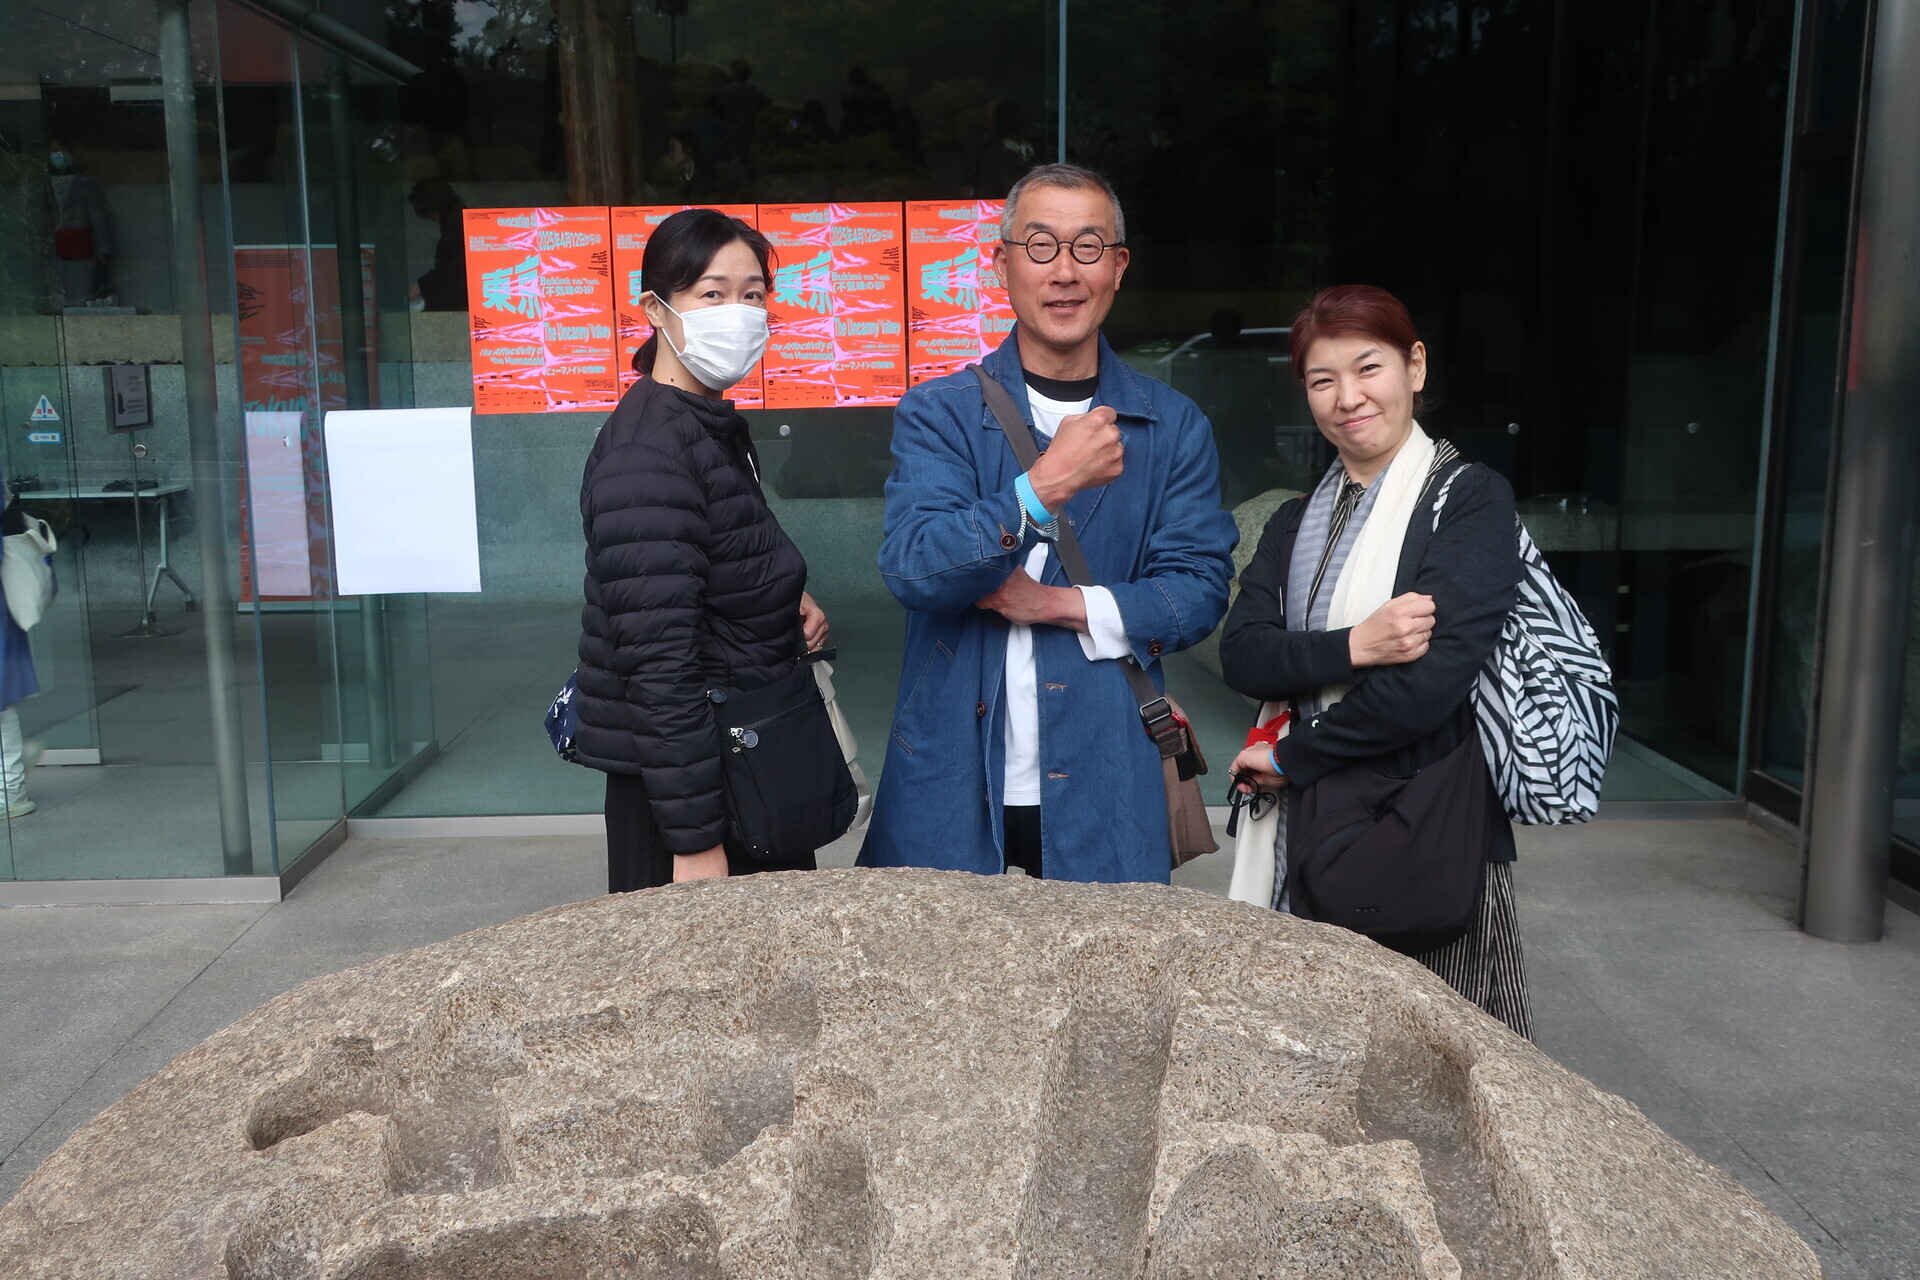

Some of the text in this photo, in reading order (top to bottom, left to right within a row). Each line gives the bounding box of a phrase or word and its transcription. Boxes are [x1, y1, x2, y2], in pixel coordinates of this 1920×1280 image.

[481, 254, 542, 319] 東京
[774, 250, 833, 314] 東京
[920, 246, 979, 311] 東京
